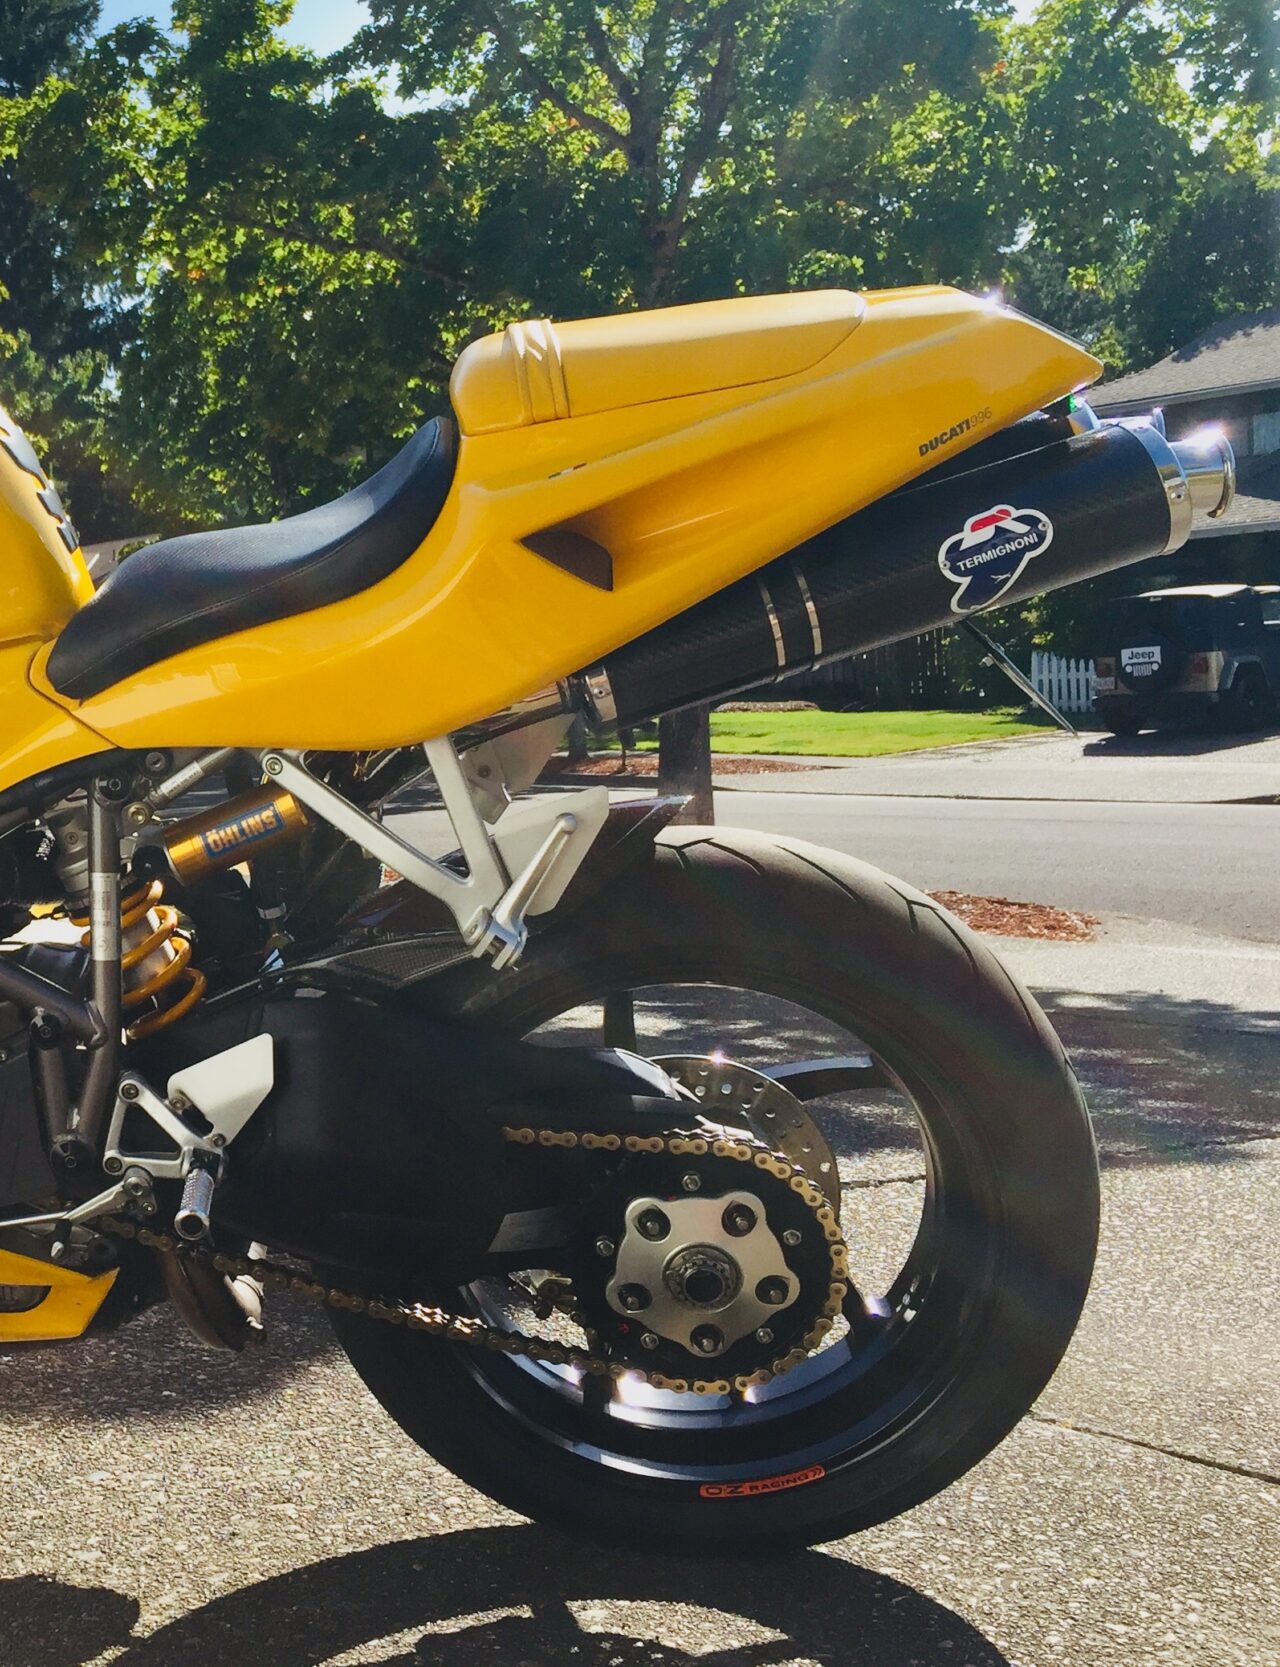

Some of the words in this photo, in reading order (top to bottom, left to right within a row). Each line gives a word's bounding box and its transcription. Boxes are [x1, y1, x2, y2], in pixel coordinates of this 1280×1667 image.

[956, 533, 1039, 571] TERMIGNONI
[1127, 650, 1155, 660] Jeep
[748, 1474, 810, 1493] RACING
